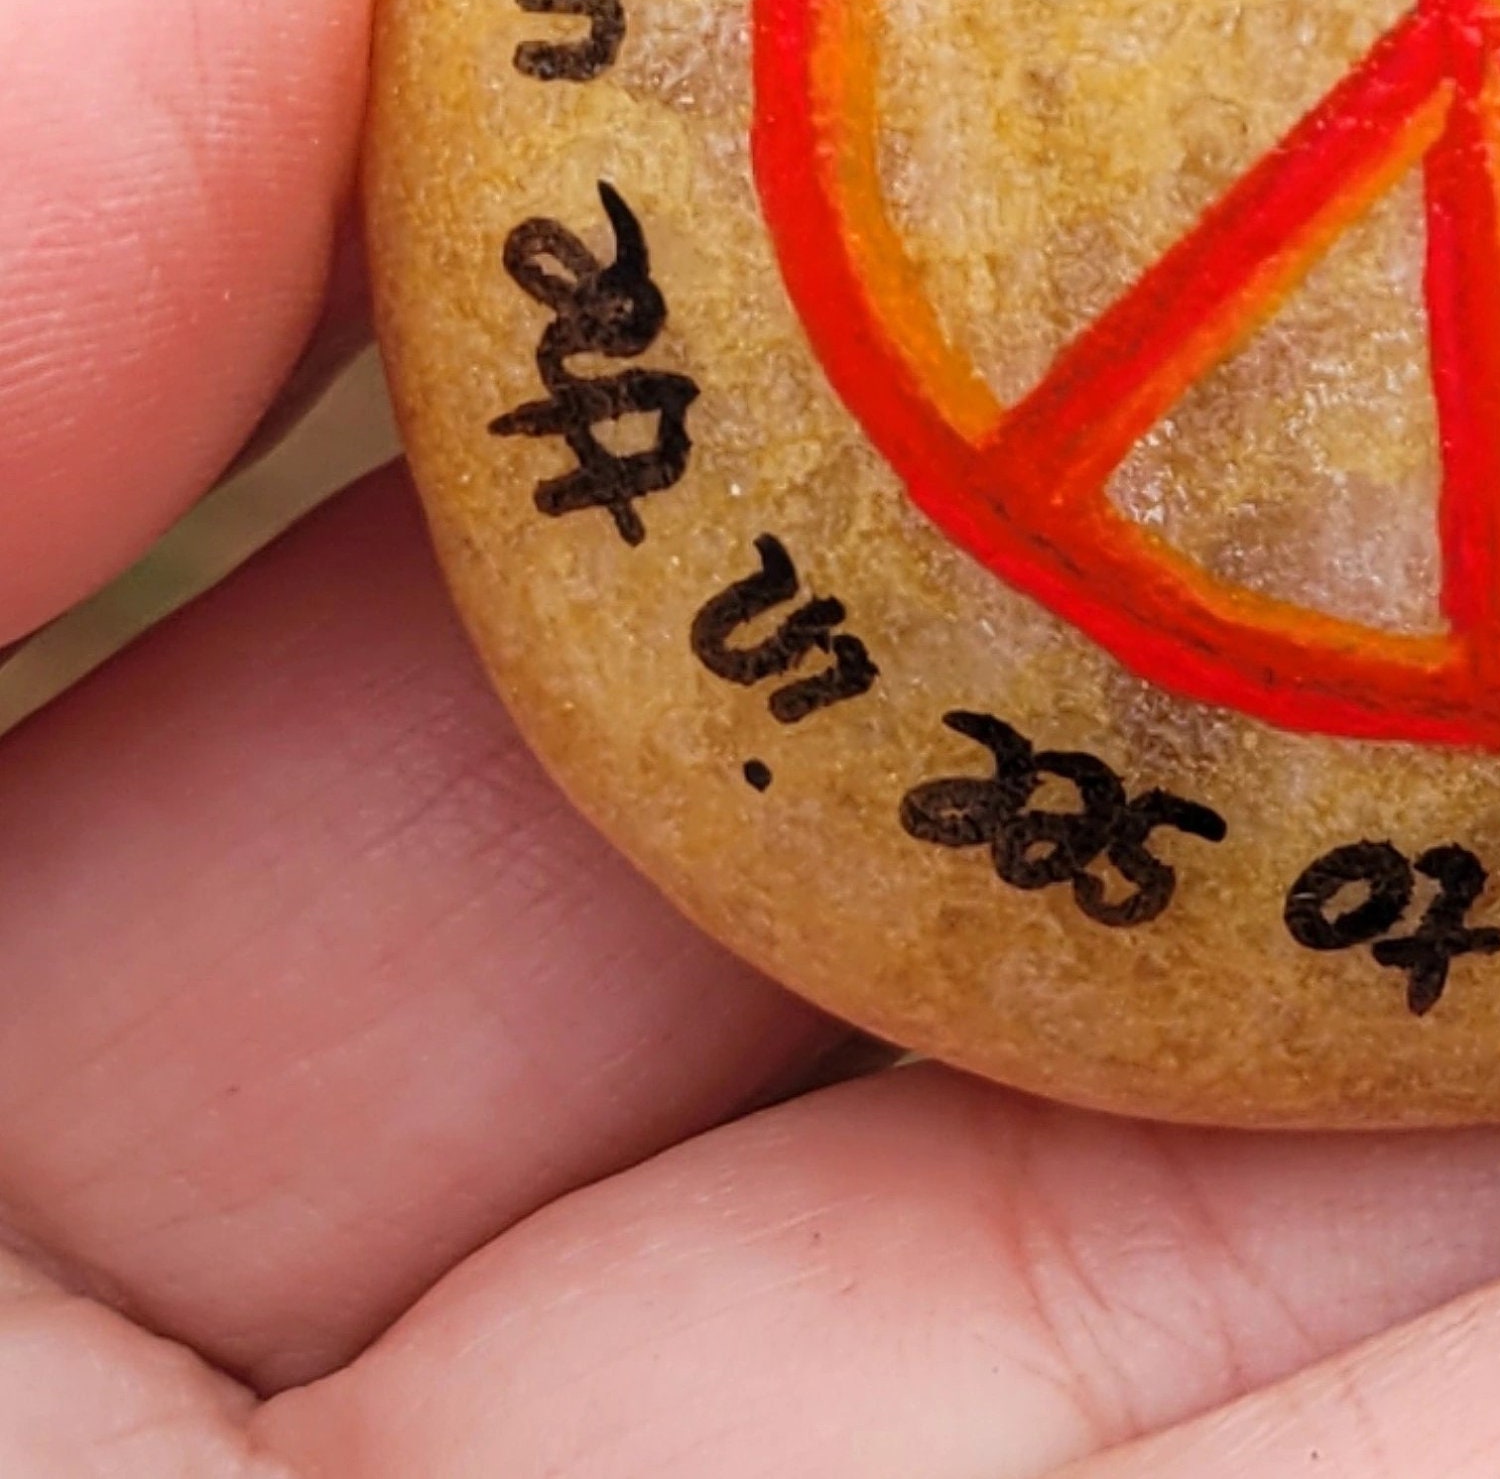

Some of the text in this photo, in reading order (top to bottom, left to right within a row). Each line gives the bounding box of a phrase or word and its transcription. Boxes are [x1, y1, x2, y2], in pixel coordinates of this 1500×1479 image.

[487, 179, 700, 546] the
[690, 533, 880, 793] in
[899, 709, 1228, 928] see
